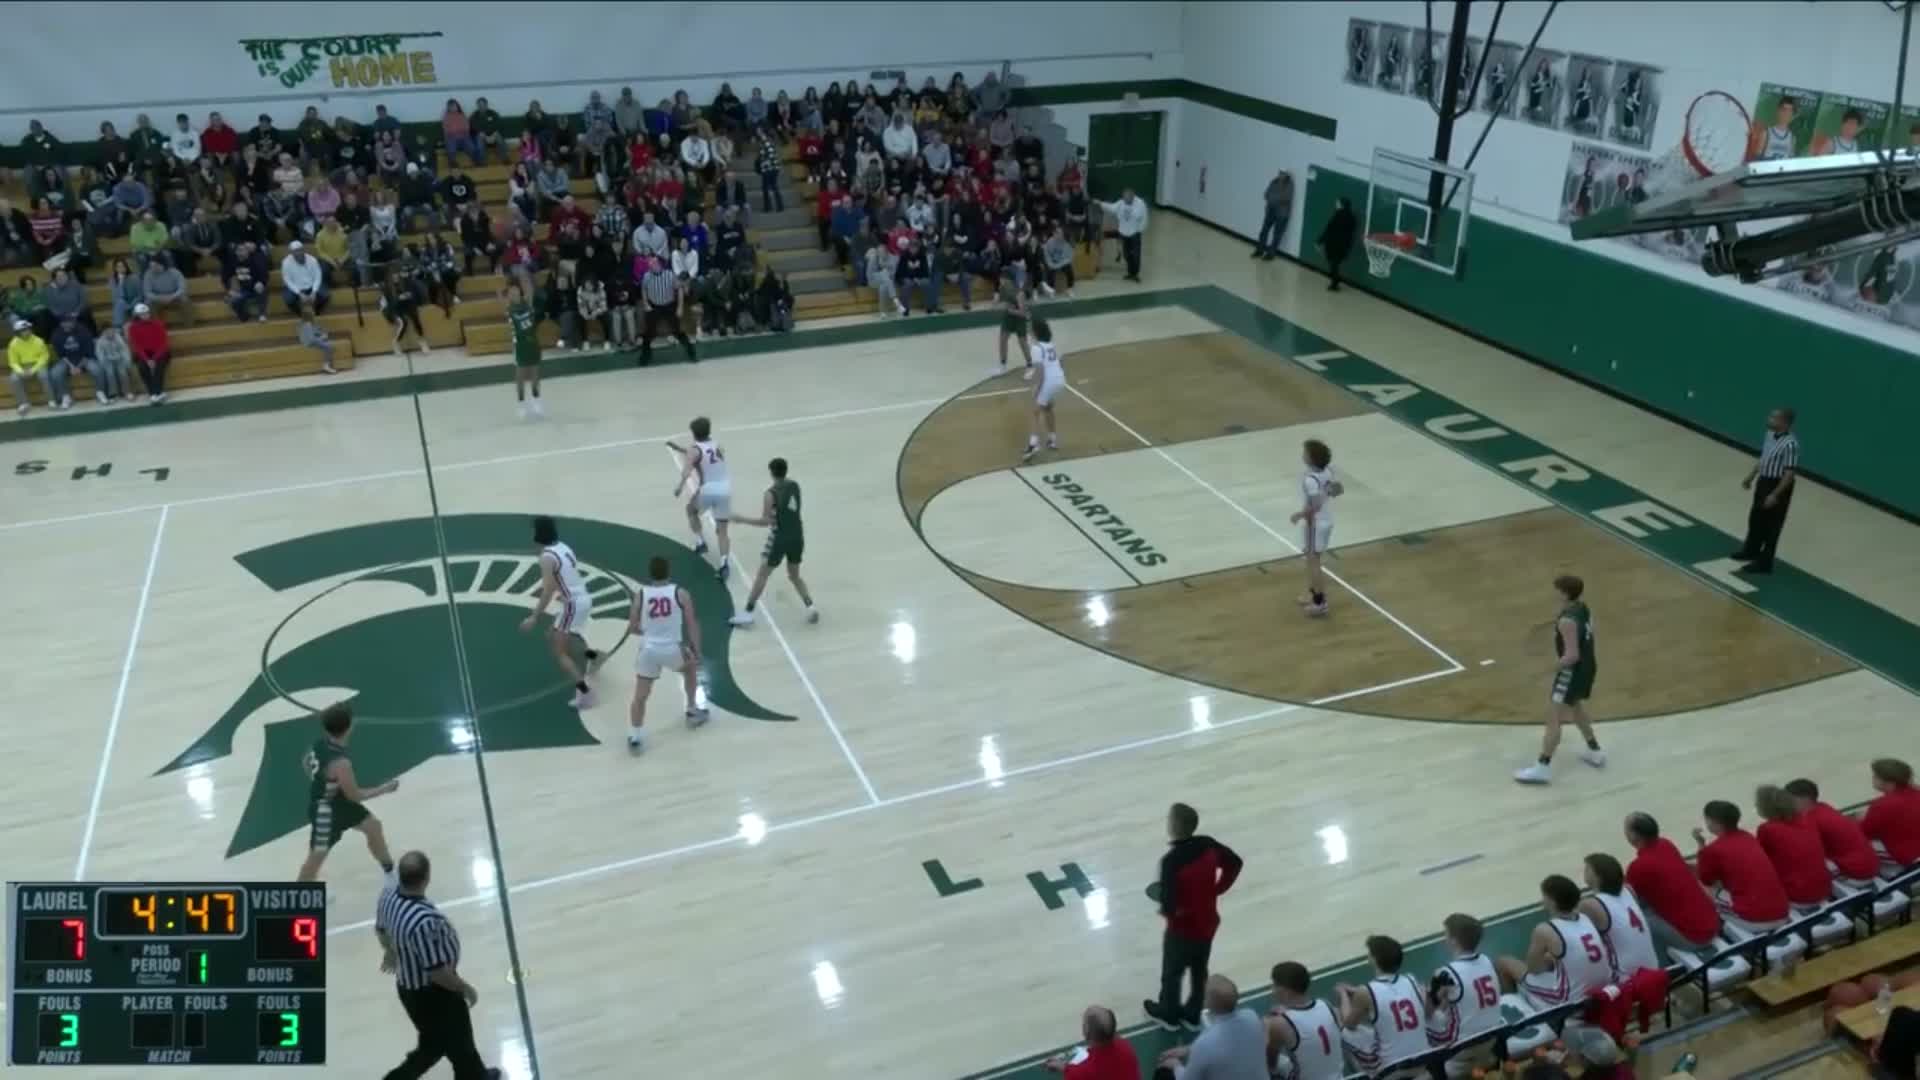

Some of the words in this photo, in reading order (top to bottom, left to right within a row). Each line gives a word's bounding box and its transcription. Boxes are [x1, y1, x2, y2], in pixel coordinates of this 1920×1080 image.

[244, 40, 284, 60] THE
[301, 37, 402, 61] COURT
[258, 61, 280, 77] IS
[280, 58, 319, 88] OUR
[328, 51, 436, 88] HOME
[1293, 350, 1760, 594] LAUREL
[1042, 473, 1168, 567] SPARTANS
[648, 597, 672, 619] 20
[1626, 906, 1644, 933] 4
[1581, 933, 1602, 964] 5
[1472, 975, 1499, 1009] 15
[1390, 998, 1420, 1033] 13
[1317, 1025, 1331, 1056] 1
